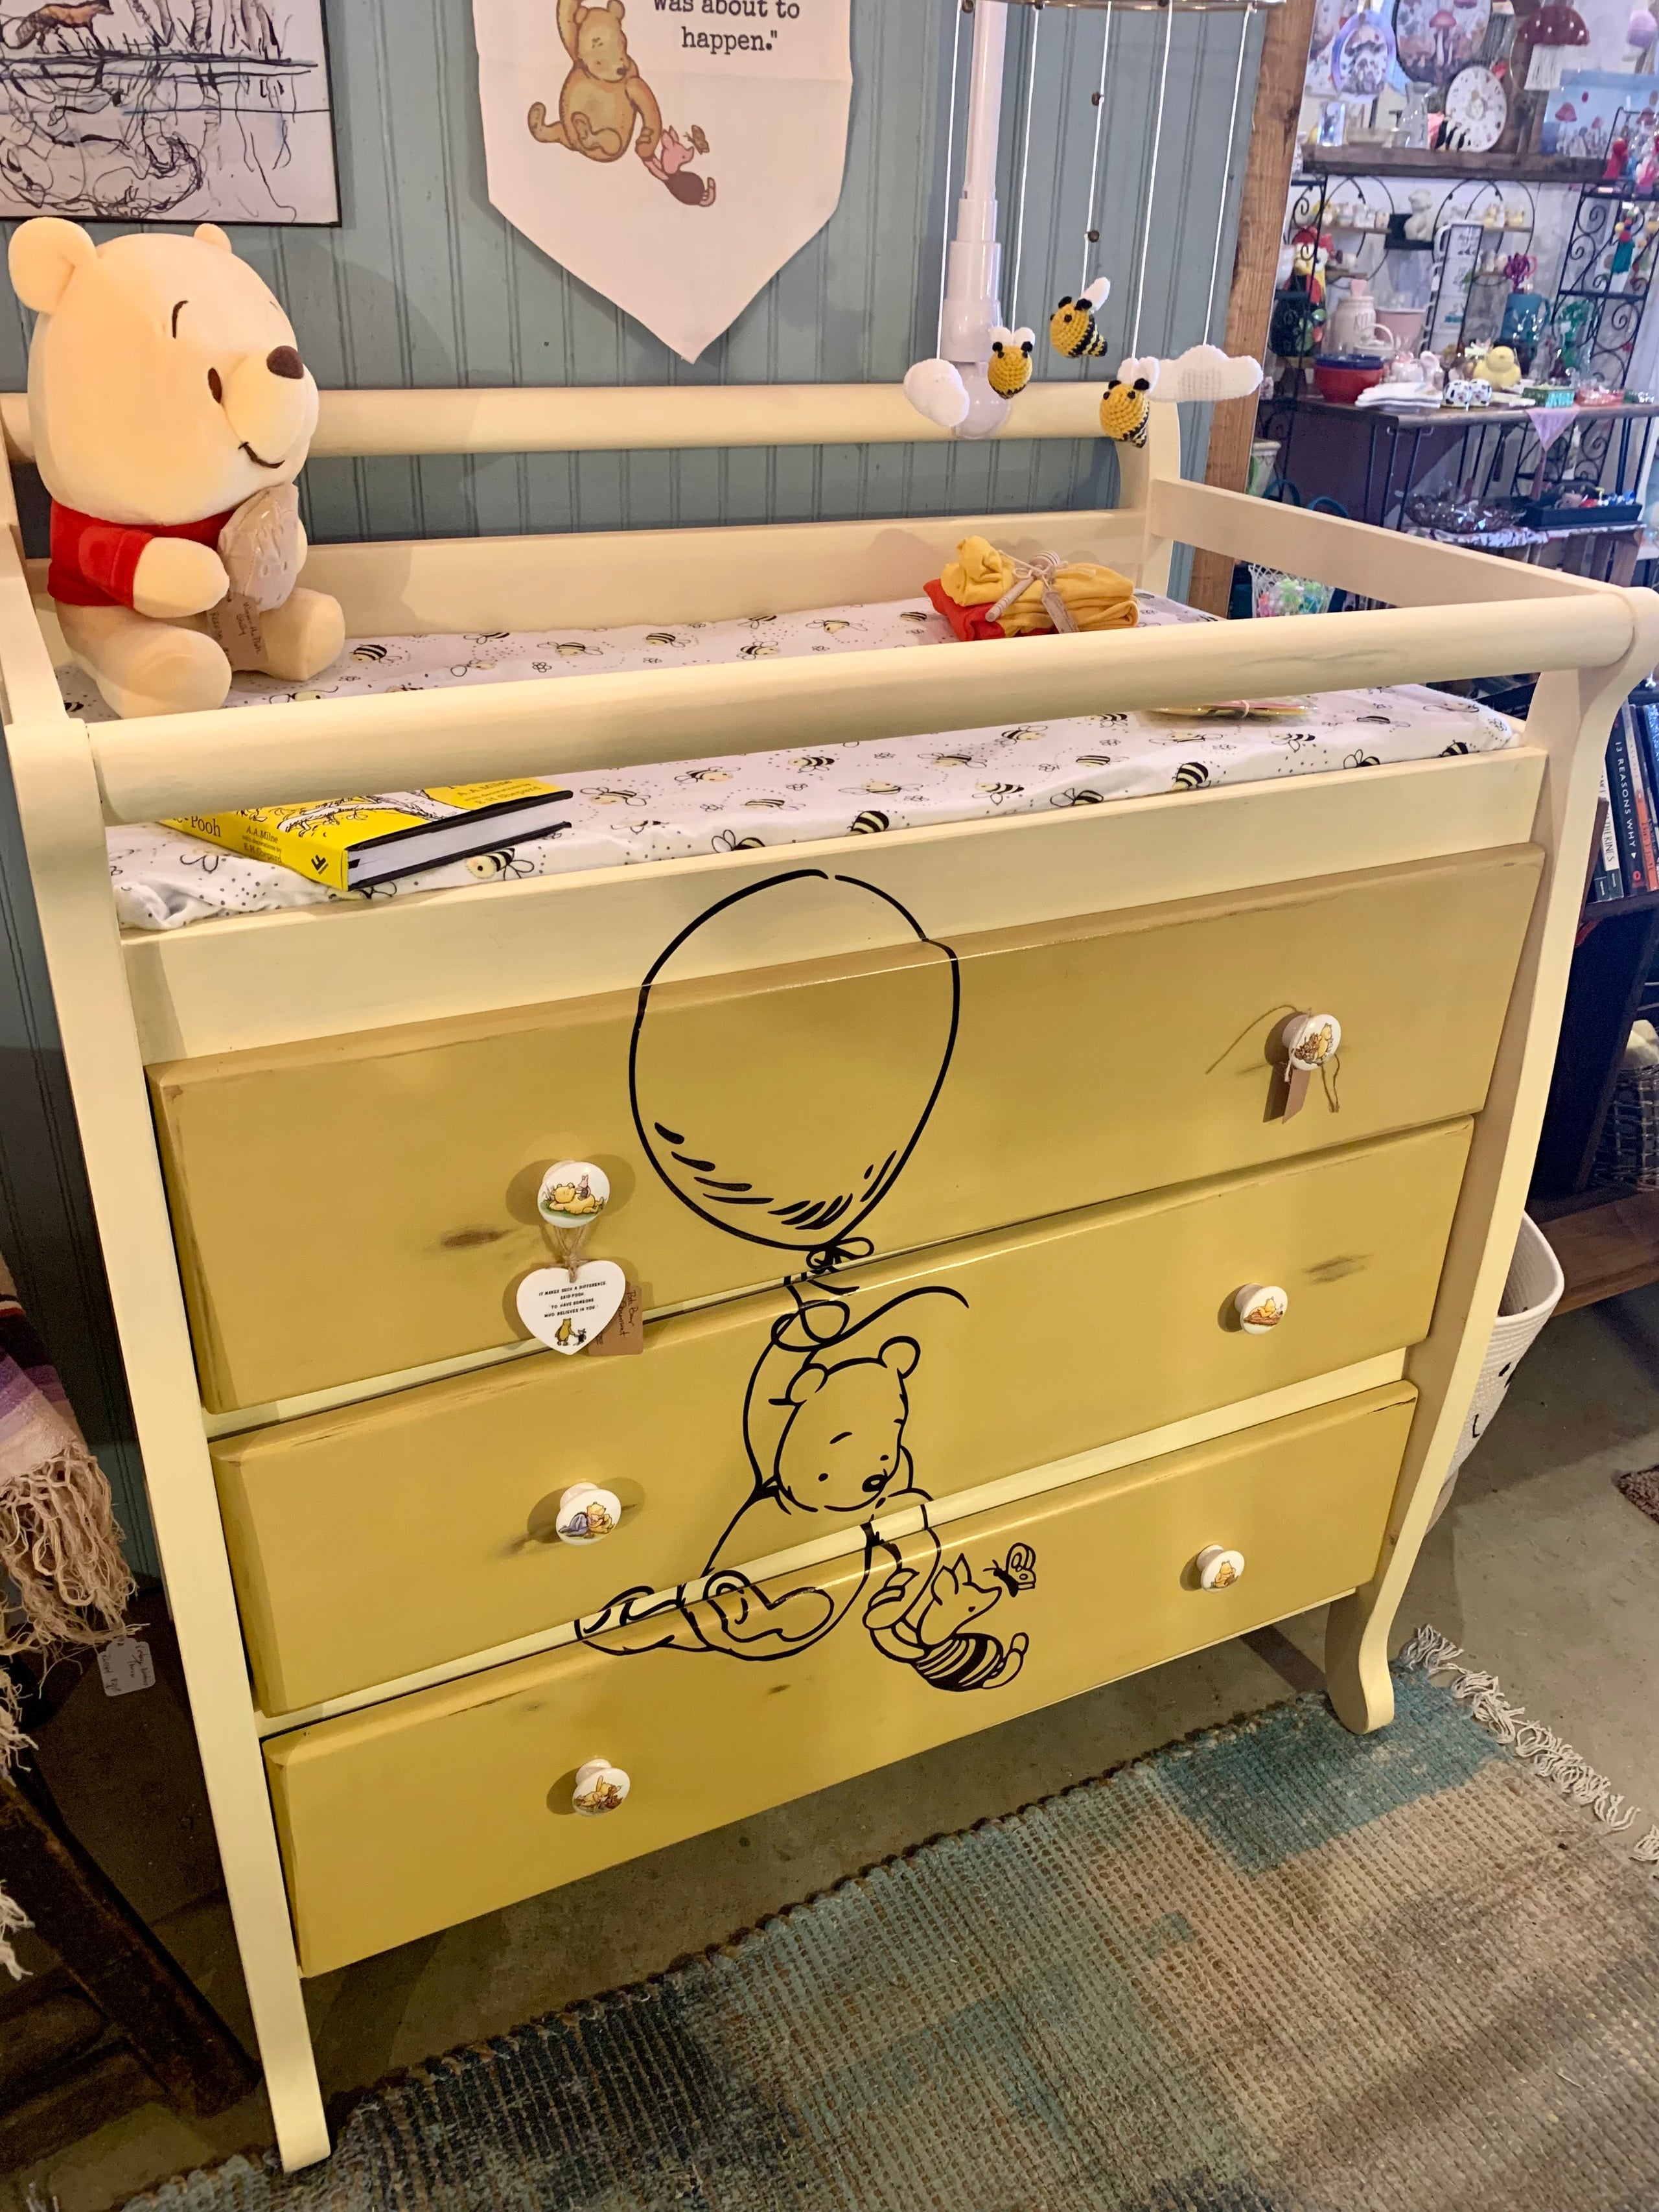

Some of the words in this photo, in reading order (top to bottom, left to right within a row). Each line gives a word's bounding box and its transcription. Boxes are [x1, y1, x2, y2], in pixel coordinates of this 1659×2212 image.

[654, 0, 694, 12] was
[701, 0, 768, 17] about
[776, 0, 800, 19] to
[681, 26, 778, 55] happen."
[1615, 742, 1623, 752] 13
[1618, 758, 1631, 815] REASONS
[1627, 819, 1636, 847] WHY
